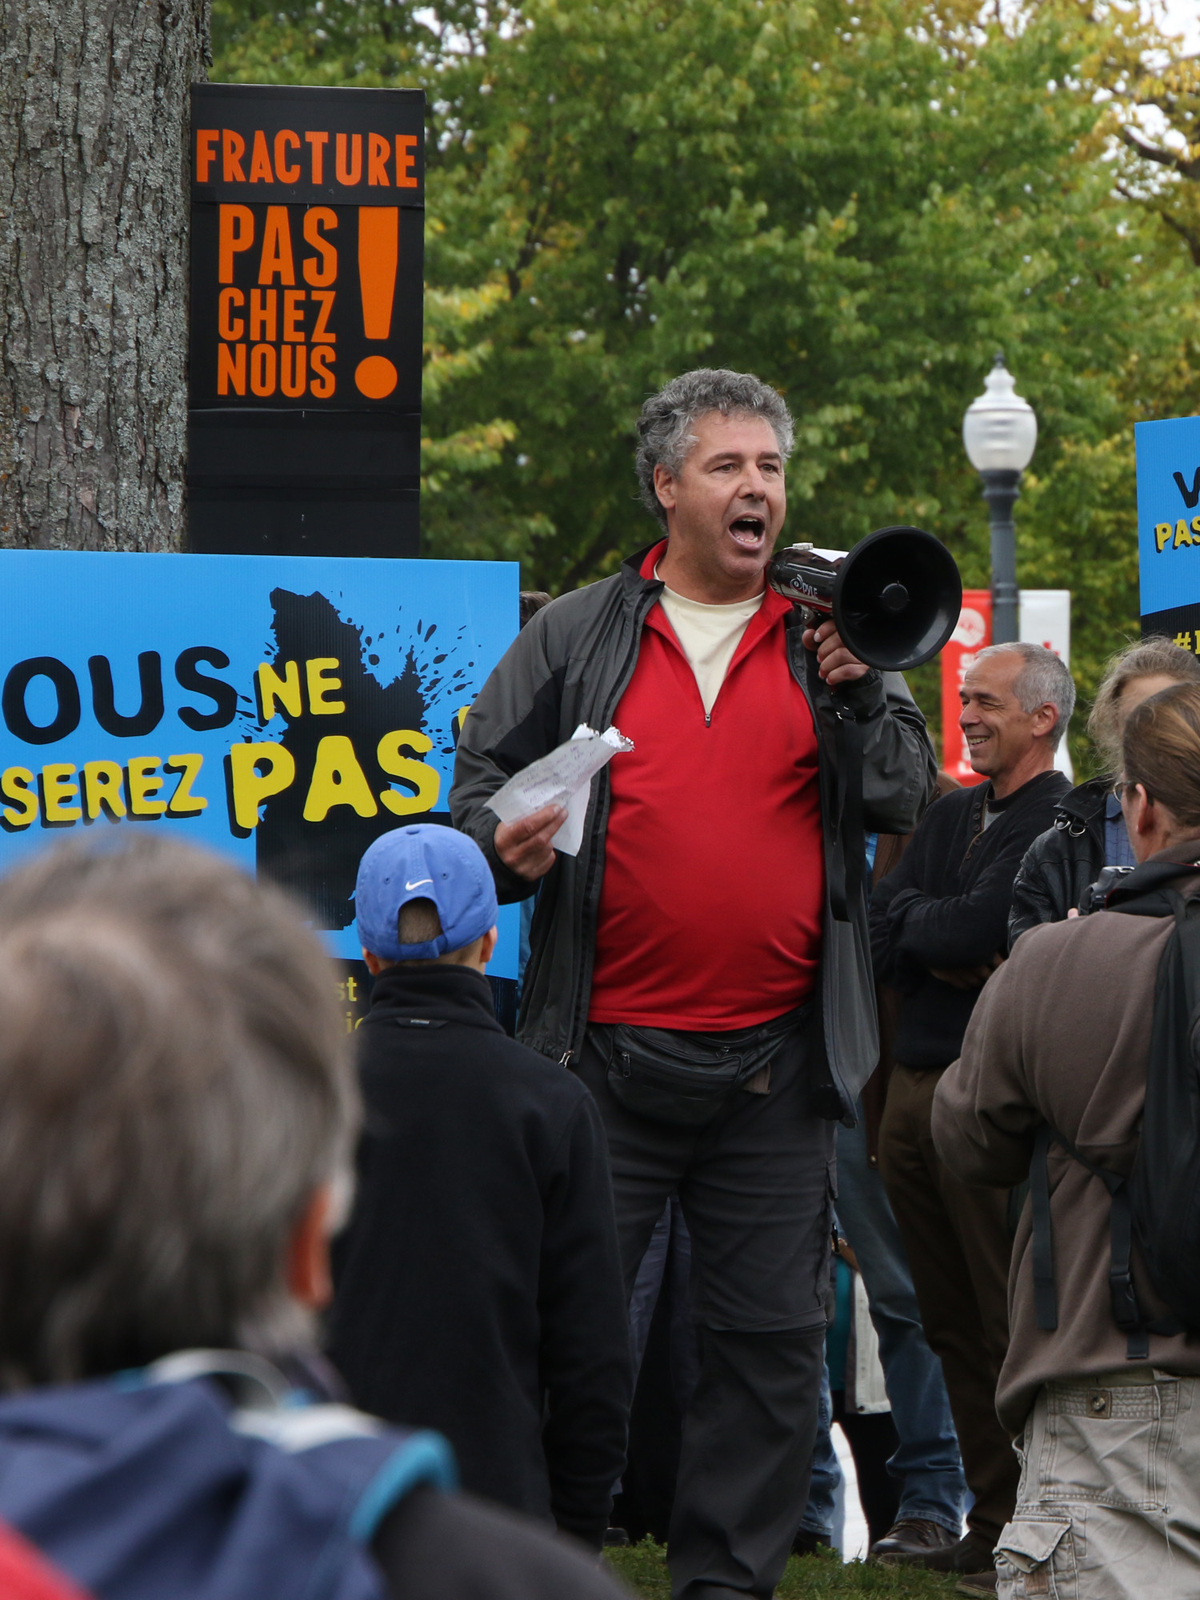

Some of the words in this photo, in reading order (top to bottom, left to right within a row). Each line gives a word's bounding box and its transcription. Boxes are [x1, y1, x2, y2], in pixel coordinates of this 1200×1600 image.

[196, 129, 418, 188] FRACTURE
[218, 203, 338, 287] PAS
[218, 287, 337, 343] CHEZ
[217, 342, 336, 399] NOUS
[258, 657, 346, 728] NE
[226, 706, 471, 838] PAS
